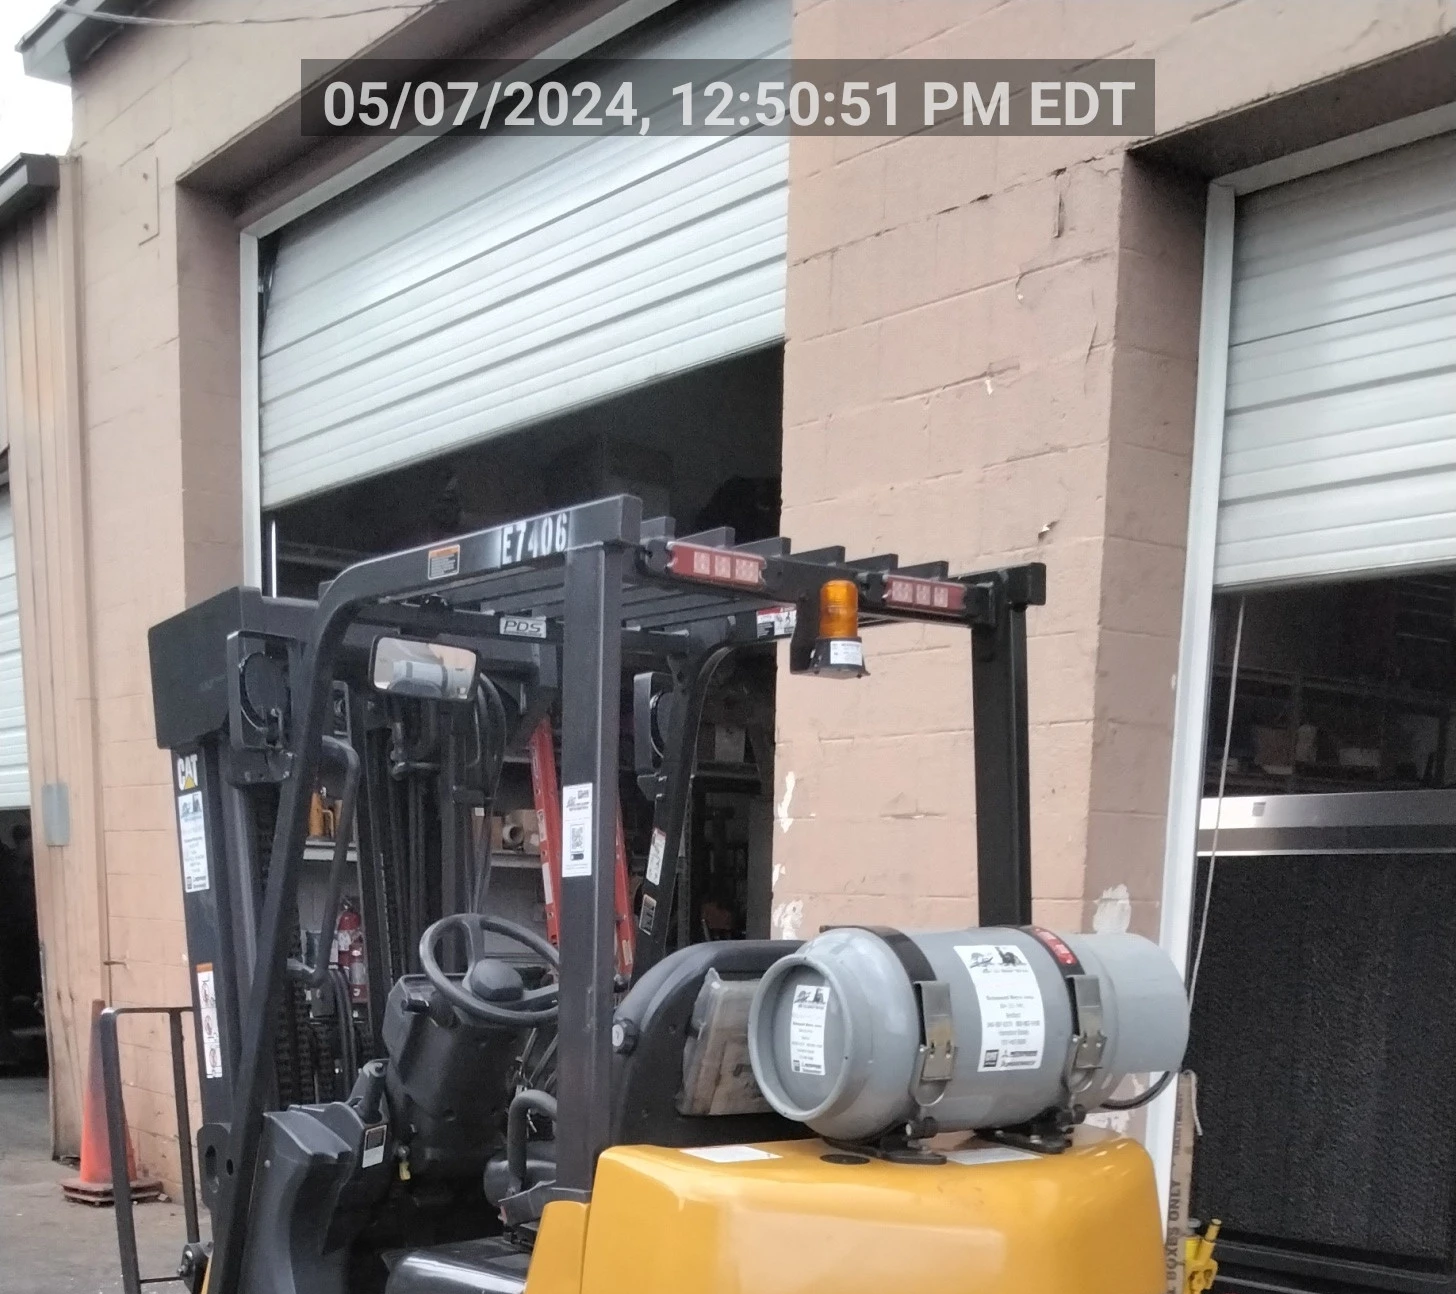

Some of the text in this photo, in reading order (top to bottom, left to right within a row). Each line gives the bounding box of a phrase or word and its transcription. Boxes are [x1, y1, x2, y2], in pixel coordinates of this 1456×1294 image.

[501, 513, 567, 565] E7406
[503, 620, 541, 632] PDS
[177, 754, 199, 790] CAT
[1168, 1180, 1181, 1221] ONLY
